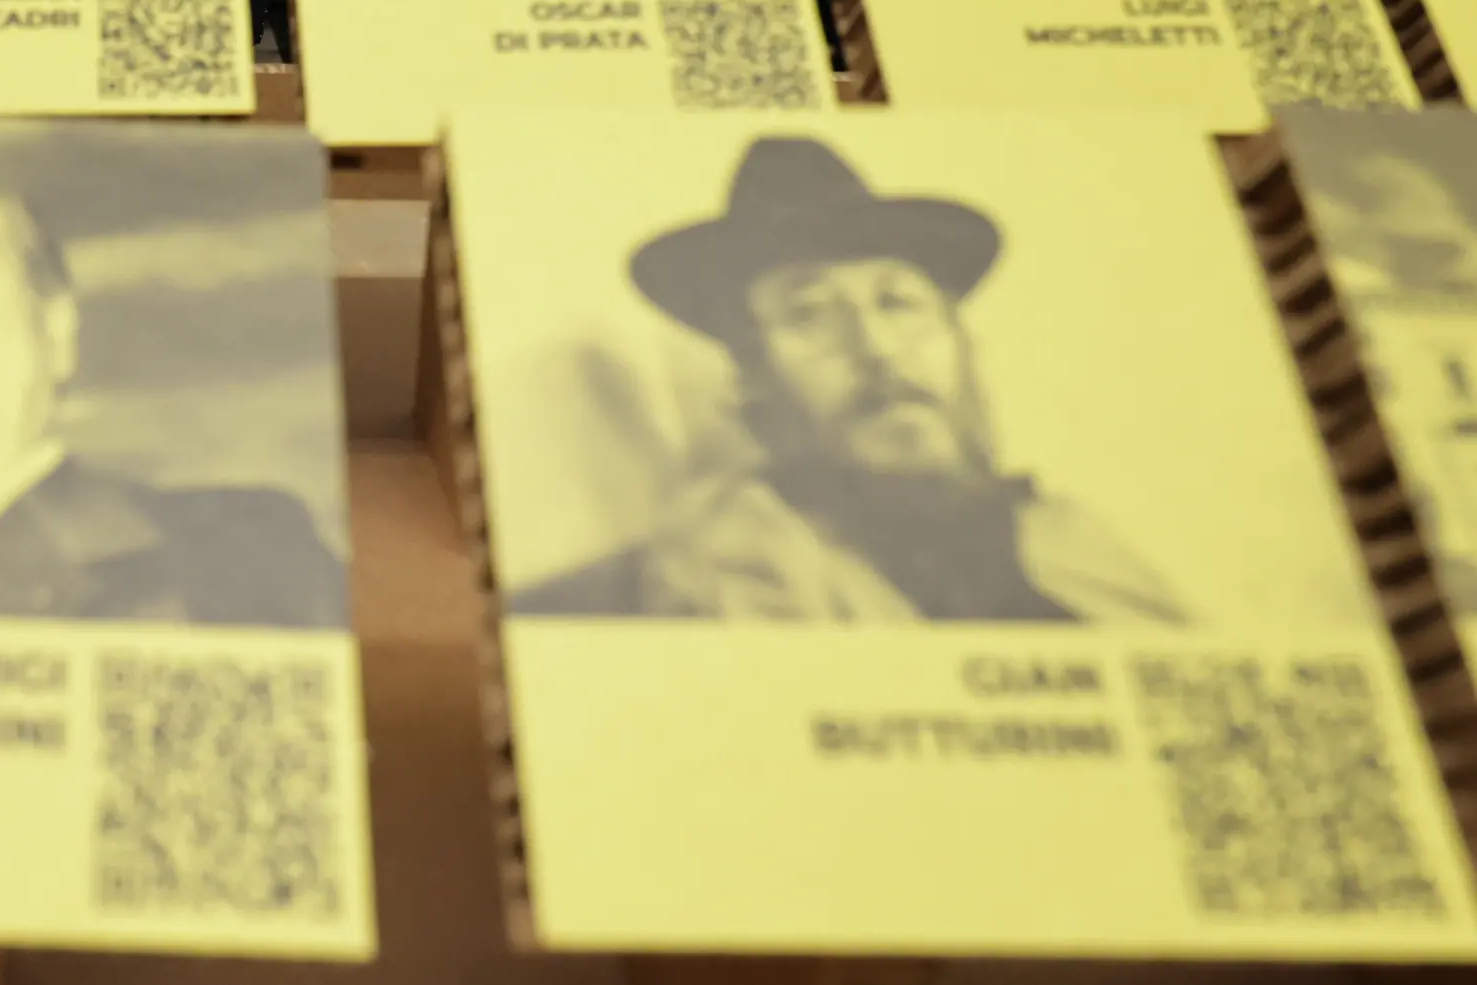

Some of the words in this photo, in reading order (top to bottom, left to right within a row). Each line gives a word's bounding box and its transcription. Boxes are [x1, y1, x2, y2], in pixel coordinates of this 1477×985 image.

[530, 0, 644, 21] OSCAR
[494, 30, 529, 52] DI
[539, 28, 650, 50] PRATA
